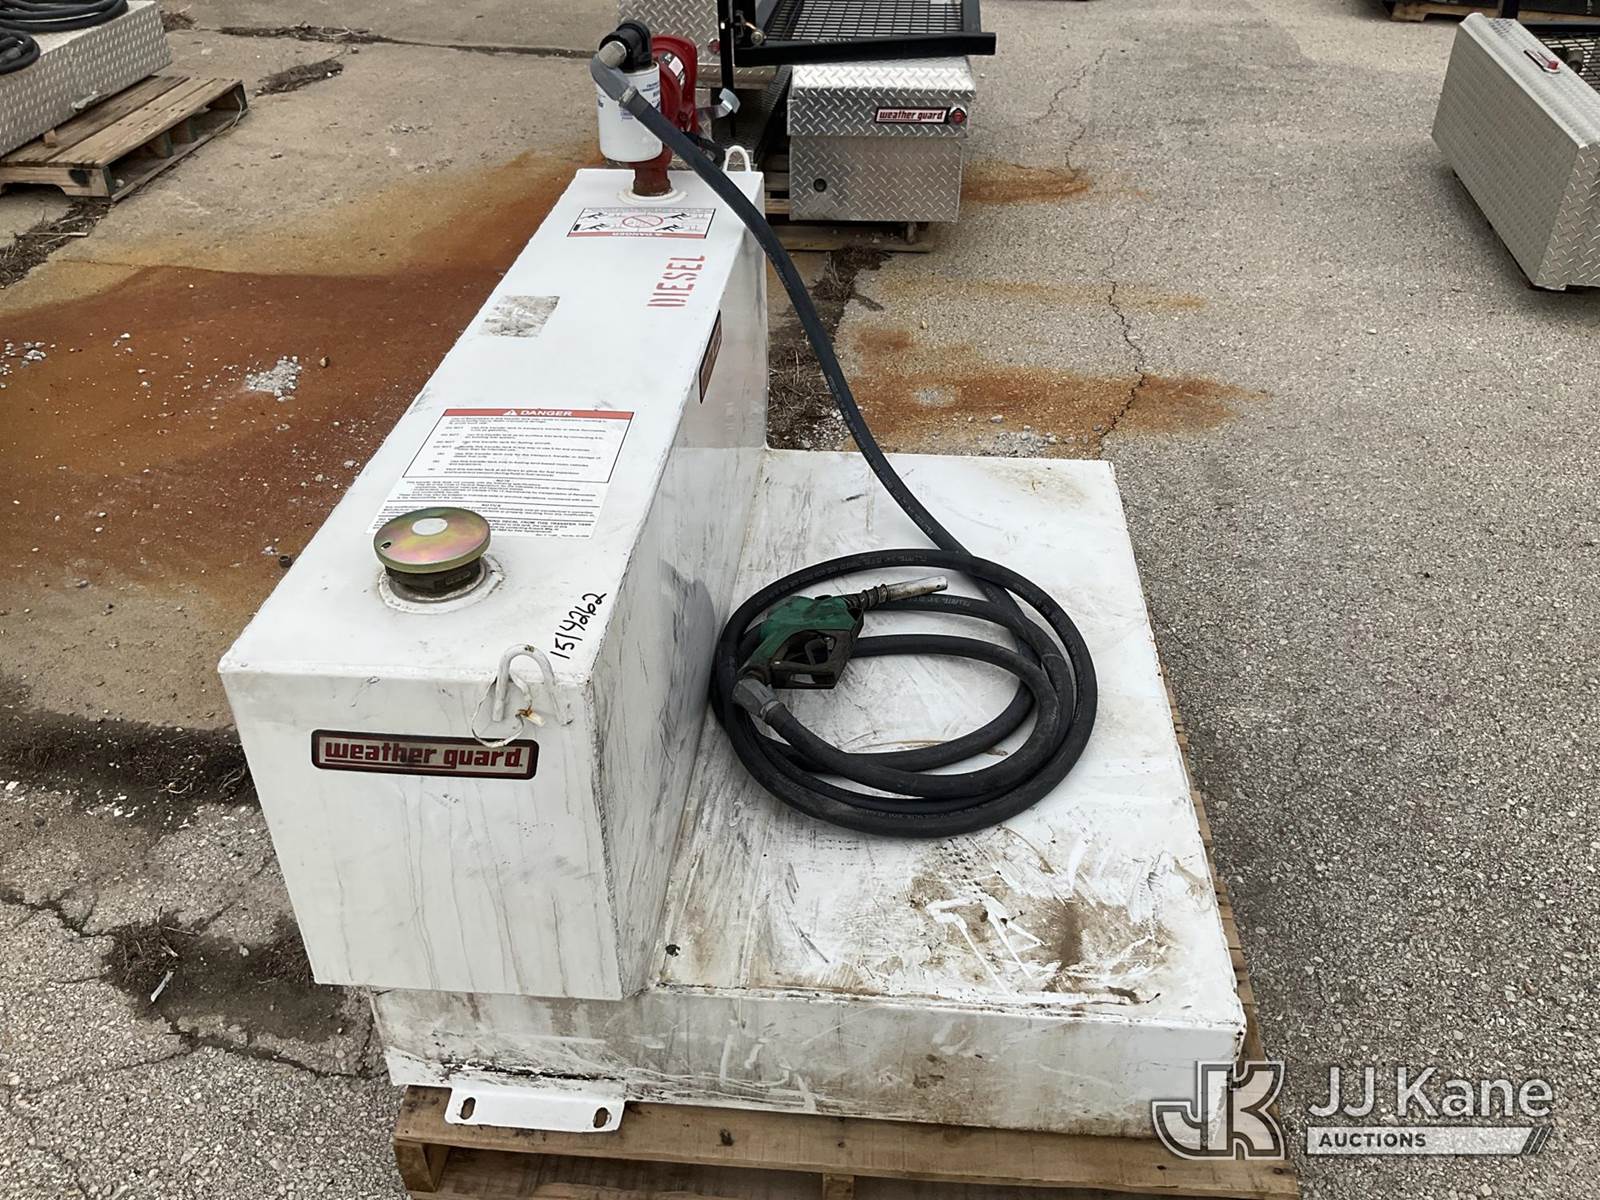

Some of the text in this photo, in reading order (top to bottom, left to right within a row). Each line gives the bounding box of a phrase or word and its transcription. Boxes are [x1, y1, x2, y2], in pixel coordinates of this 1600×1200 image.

[879, 110, 944, 121] weather guard
[647, 255, 705, 307] DIESEL
[549, 592, 608, 660] 1514262
[325, 742, 523, 769] weather guard
